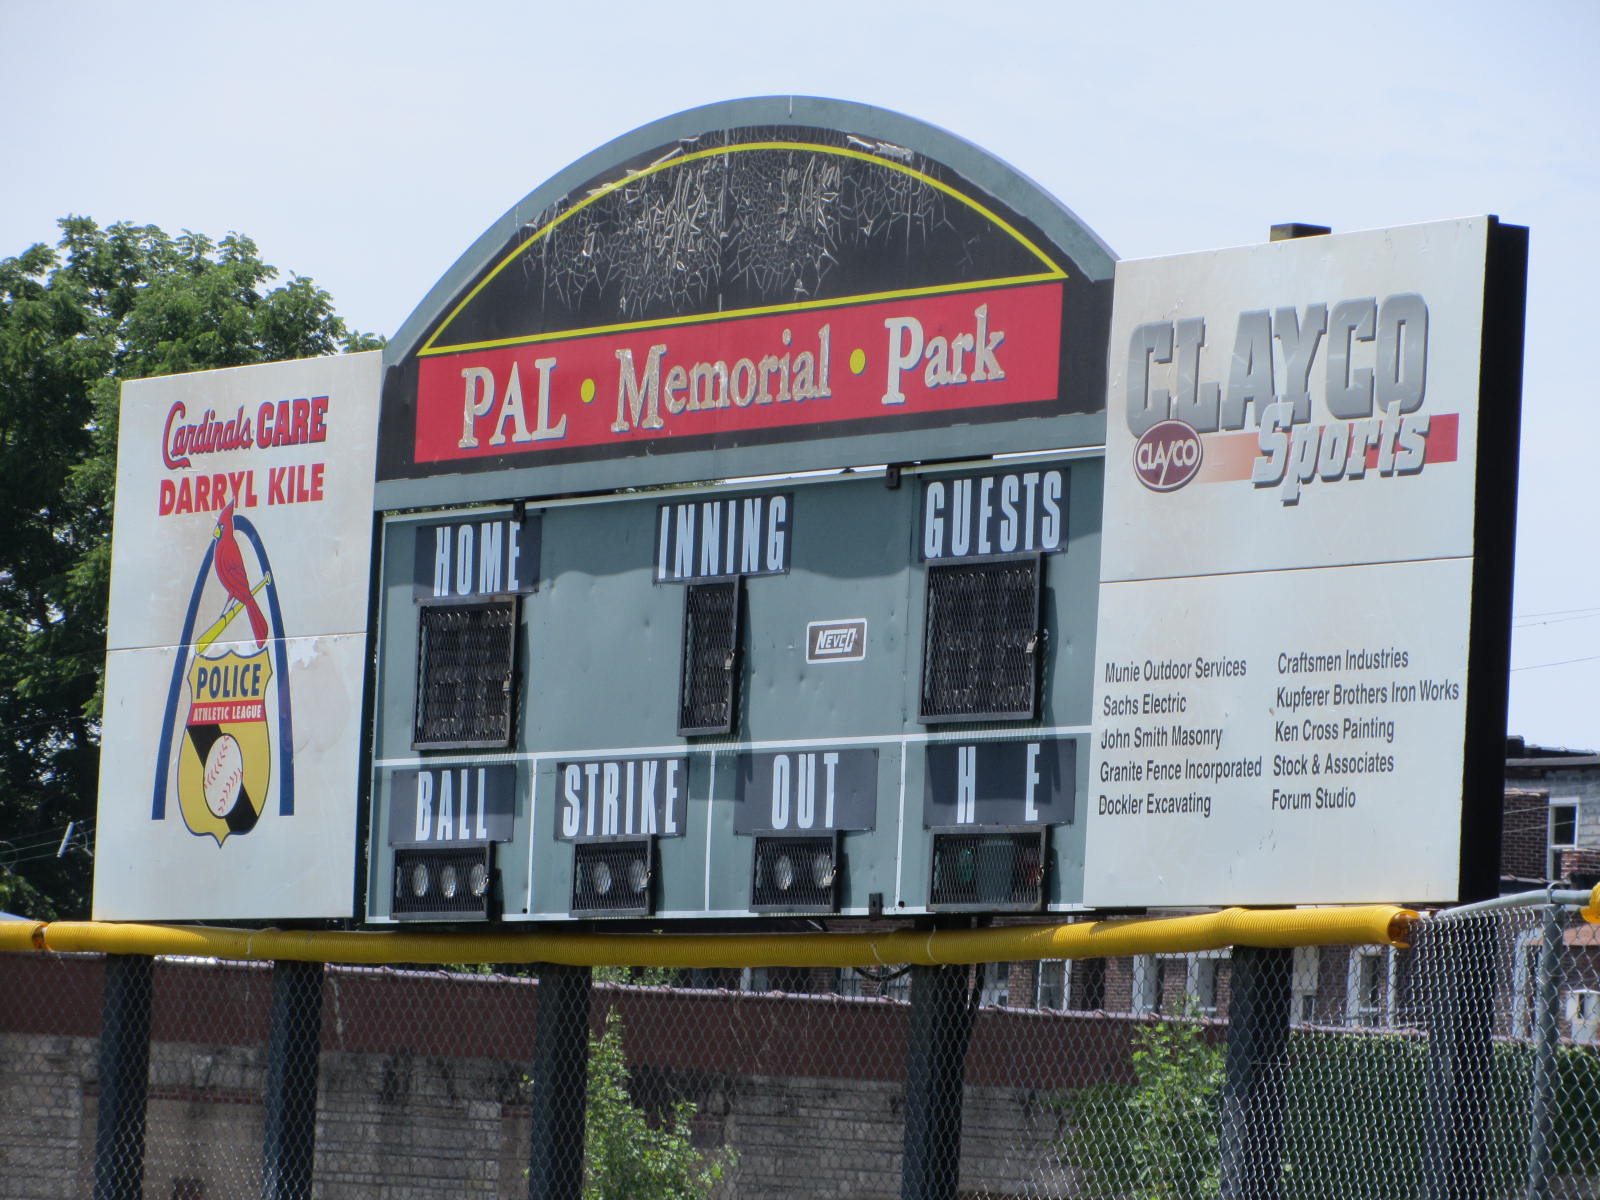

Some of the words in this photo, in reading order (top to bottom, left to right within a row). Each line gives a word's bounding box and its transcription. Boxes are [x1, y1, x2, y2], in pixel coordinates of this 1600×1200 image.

[458, 356, 567, 449] PAL
[611, 324, 832, 433] Memorial
[881, 303, 1006, 405] Park
[1126, 292, 1429, 438] CLAYCO
[163, 400, 254, 470] Cardinals
[256, 395, 330, 449] CARE
[1252, 400, 1431, 507] Sports
[1137, 437, 1197, 488] CLAYCO
[159, 470, 257, 517] DARRYL
[267, 463, 325, 506] KILE
[924, 470, 1063, 558] GUESTS
[433, 519, 521, 597] HOME
[658, 496, 787, 579] INNING
[196, 663, 262, 699] POLICE
[1105, 661, 1141, 683] Munie
[1143, 658, 1193, 682] Outdoor
[1195, 655, 1247, 679] Services
[1277, 651, 1342, 674] Craftsmen
[1345, 646, 1409, 671] Industries
[192, 705, 229, 722] ATHLETIC
[232, 704, 262, 720] LEAGUE
[1103, 694, 1139, 716] Sachs
[1142, 691, 1187, 714] Electric
[1276, 685, 1330, 713] Kupferer
[1333, 682, 1388, 706] Brothers
[1391, 680, 1416, 703] Iron
[1419, 678, 1460, 701] Works
[1100, 728, 1130, 750] John
[1133, 725, 1168, 748] Smith
[1171, 724, 1223, 750] Masonry
[1275, 720, 1299, 742] Ken
[1302, 719, 1339, 741] Cross
[1342, 716, 1395, 743] Painting
[956, 746, 976, 824] H
[1025, 743, 1041, 821] E
[1100, 760, 1142, 782] Granite
[1146, 759, 1181, 780] Fence
[1185, 755, 1262, 784] Incorporated
[1273, 753, 1308, 776] Stock
[1311, 752, 1320, 775] &
[1324, 751, 1395, 774] Associates
[415, 768, 487, 841] BALL
[562, 759, 679, 837] STRIKE
[771, 752, 839, 830] OUT
[1098, 793, 1143, 815] Dockler
[1146, 791, 1211, 818] Excavating
[1271, 788, 1312, 810] Forum
[1315, 786, 1357, 809] Studio
